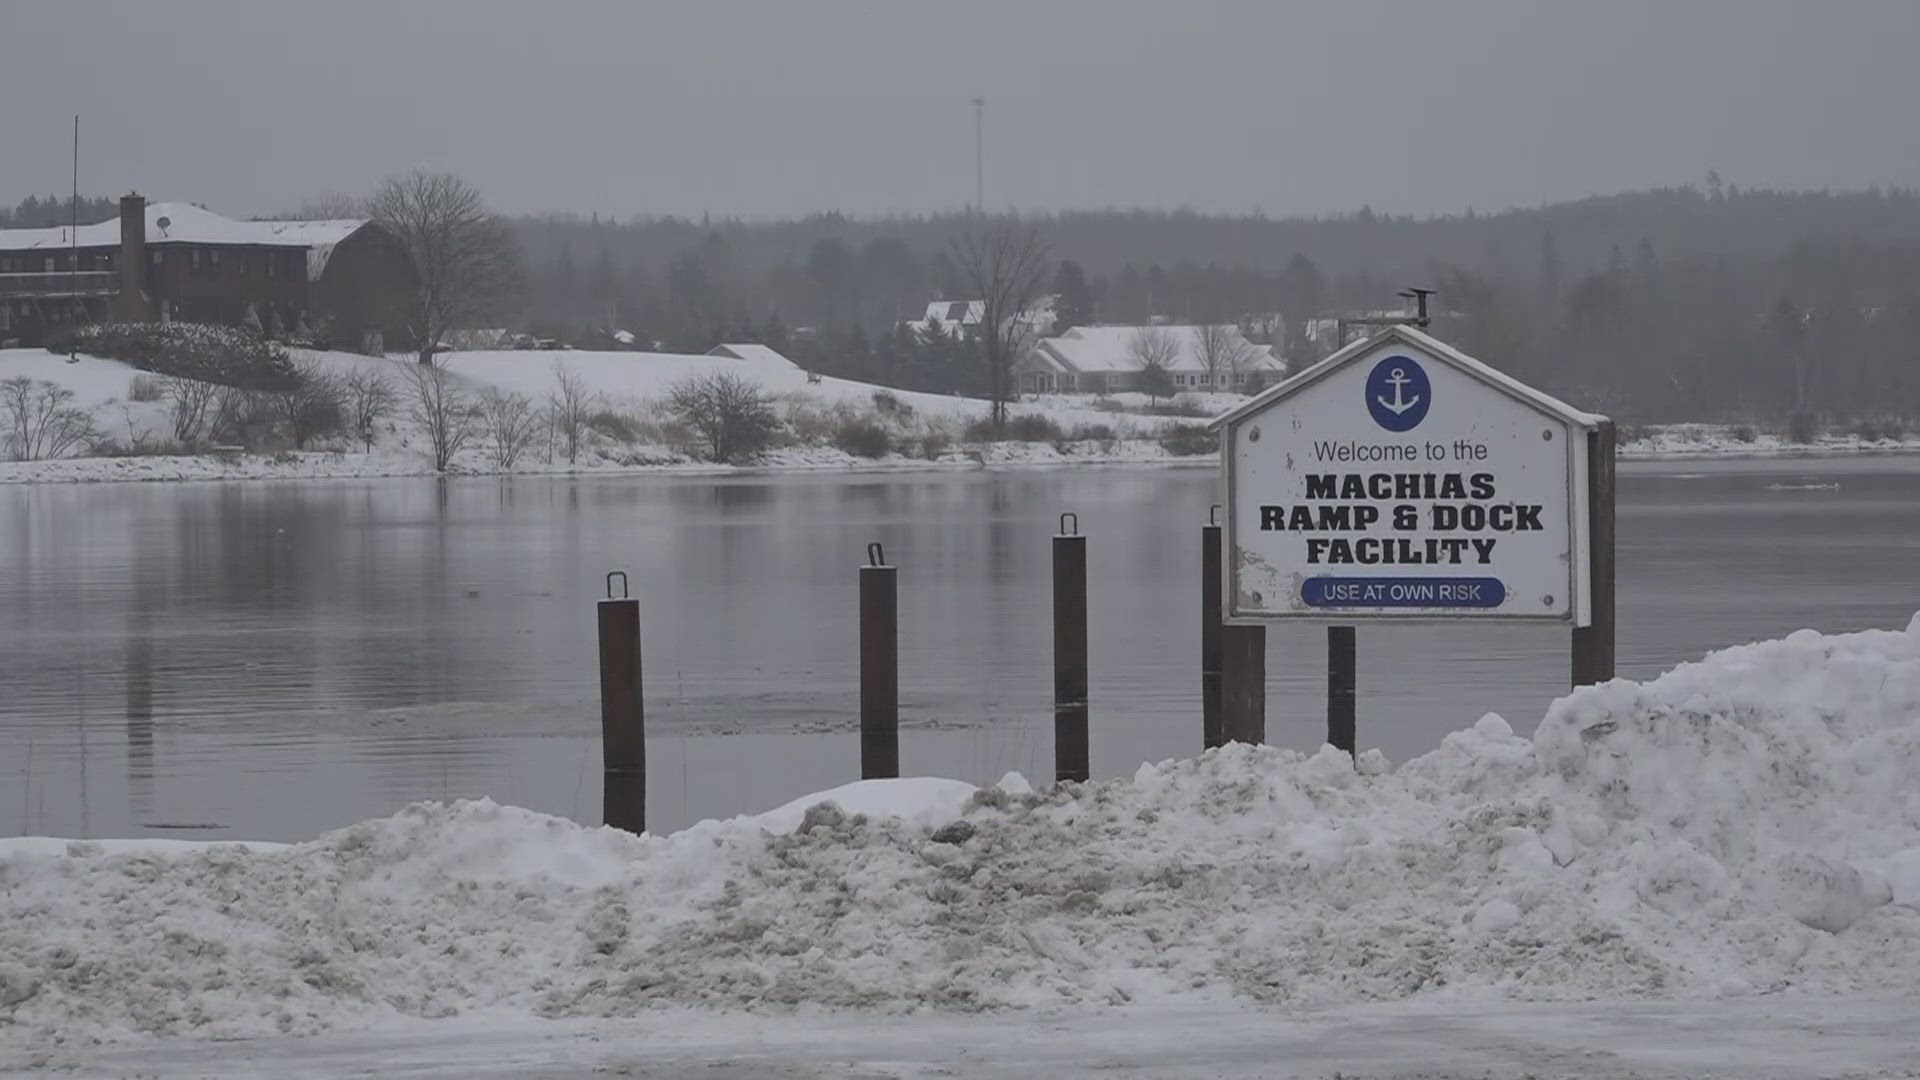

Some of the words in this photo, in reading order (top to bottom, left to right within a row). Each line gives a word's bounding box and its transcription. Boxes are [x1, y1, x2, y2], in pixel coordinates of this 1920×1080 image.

[1313, 440, 1418, 462] Welcome
[1425, 441, 1446, 461] to
[1453, 440, 1488, 461] the
[1305, 473, 1496, 500] MACHIAS
[1259, 505, 1379, 531] RAMP
[1392, 505, 1419, 531] &
[1432, 504, 1543, 531] DOCK
[1306, 538, 1497, 564] FACILITY
[1323, 584, 1360, 601] USE
[1363, 584, 1387, 601] AT
[1390, 584, 1434, 601] OWN
[1439, 584, 1481, 601] RISK
